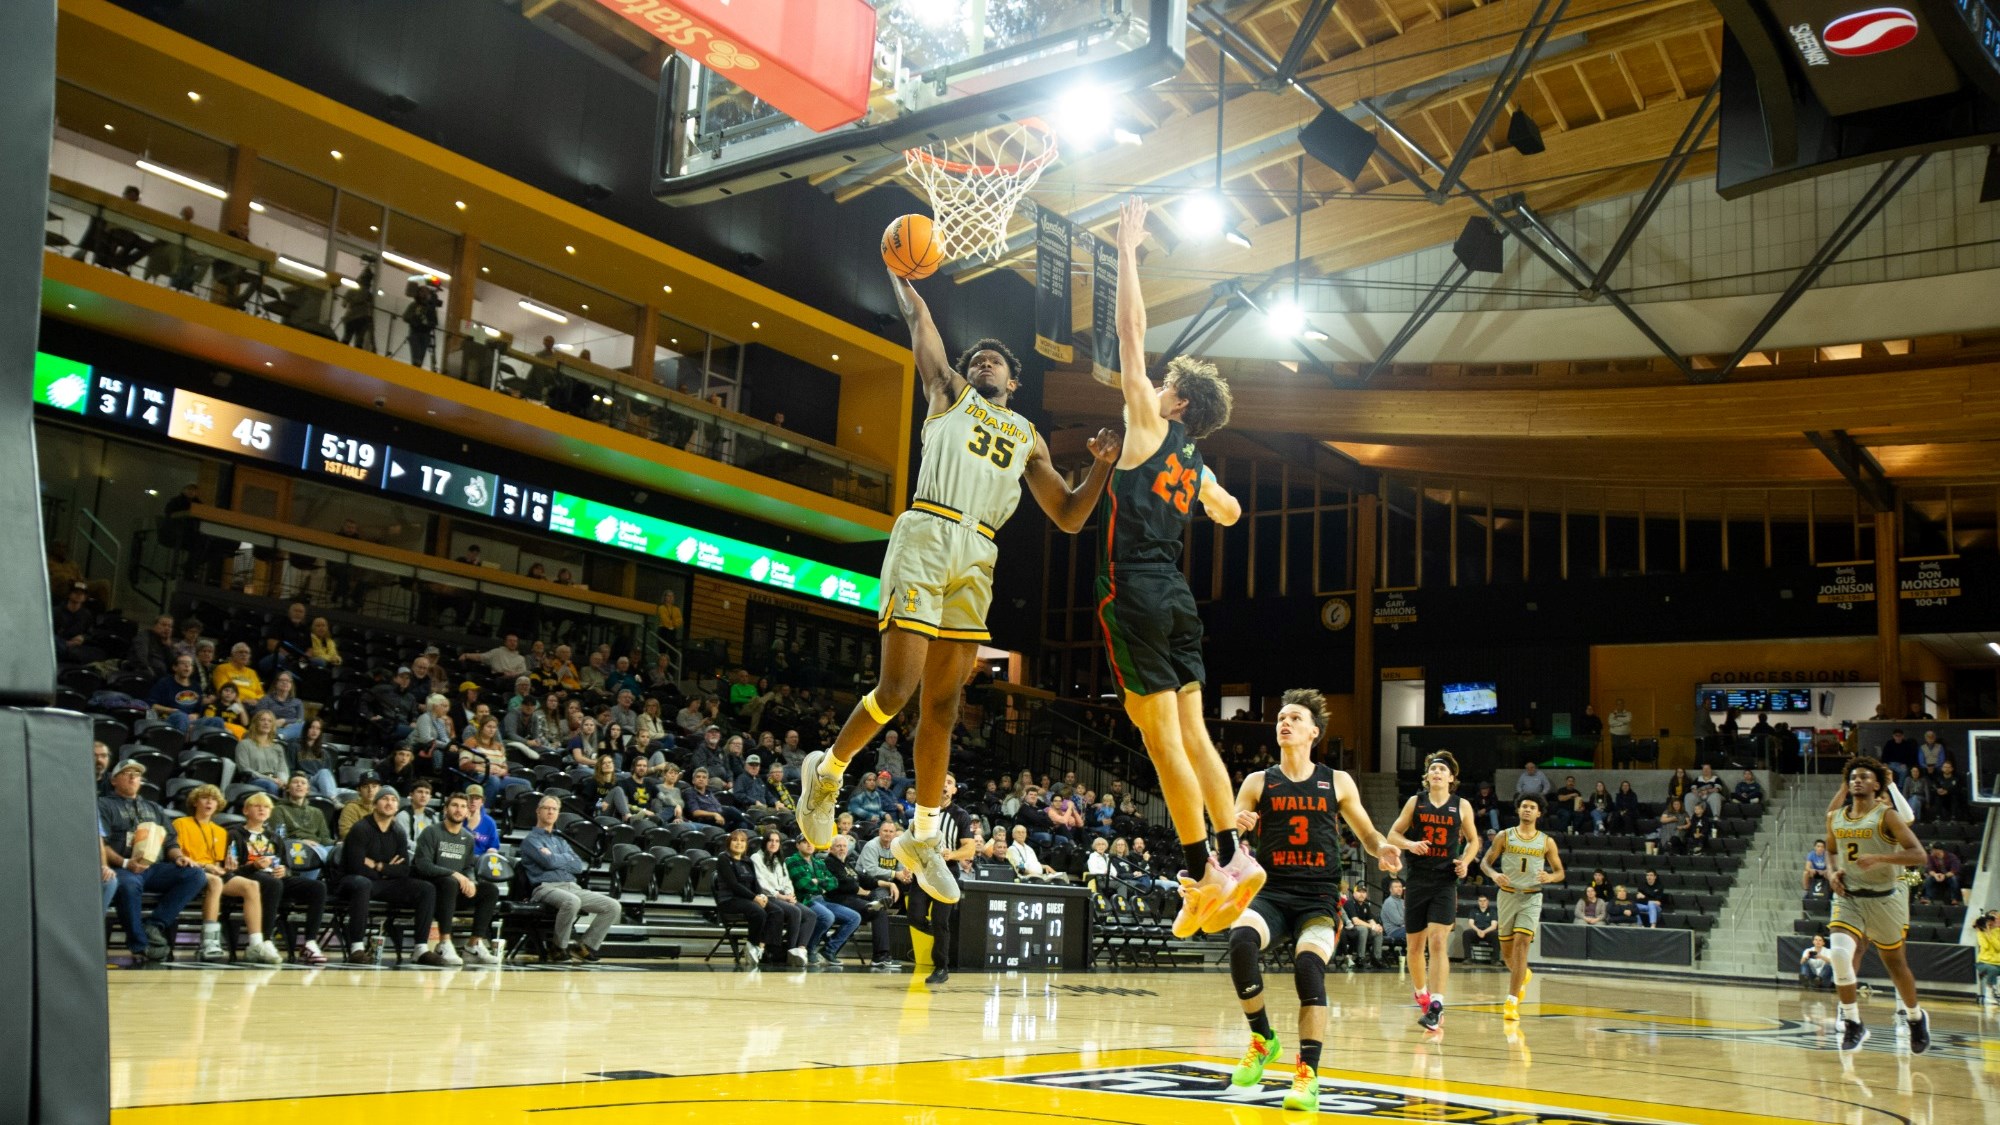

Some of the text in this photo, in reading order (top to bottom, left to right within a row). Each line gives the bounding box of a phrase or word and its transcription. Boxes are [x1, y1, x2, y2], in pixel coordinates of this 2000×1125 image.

[612, 0, 713, 45] Stat
[1789, 23, 1829, 66] SAFEWAY
[99, 376, 123, 393] FLS
[100, 394, 117, 414] 3
[142, 405, 159, 425] 4
[965, 403, 1028, 443] IDAHO
[232, 418, 272, 450] 45
[320, 433, 375, 468] 5:19
[967, 425, 1015, 471] 35
[324, 460, 369, 481] 1ST HALF
[420, 465, 452, 495] 17
[1152, 452, 1197, 514] 25
[503, 498, 516, 515] 3
[532, 505, 544, 522] 8
[1835, 575, 1857, 584] GUS
[1901, 578, 1960, 590] MONSON
[1918, 571, 1942, 580] DON
[1818, 583, 1874, 595] JOHNSON
[1385, 600, 1407, 608] GARY
[1915, 598, 1948, 607] 100-41
[1375, 607, 1416, 617] SIMMONS
[1710, 670, 1860, 683] CONCESSIONS
[1271, 796, 1328, 812] WALLA
[1419, 813, 1454, 826] WALLA
[1288, 816, 1309, 846] 3
[1422, 826, 1448, 845] 33
[1272, 851, 1326, 867] WALLA
[1508, 845, 1544, 857] IDAHO
[1847, 843, 1859, 863] 2
[1521, 857, 1528, 873] 1
[989, 900, 1007, 911] HOME
[1017, 901, 1043, 921] 5:19
[1046, 903, 1064, 914] GUEST
[989, 917, 1004, 937] 45
[1050, 919, 1062, 937] 17
[1024, 941, 1029, 958] 1
